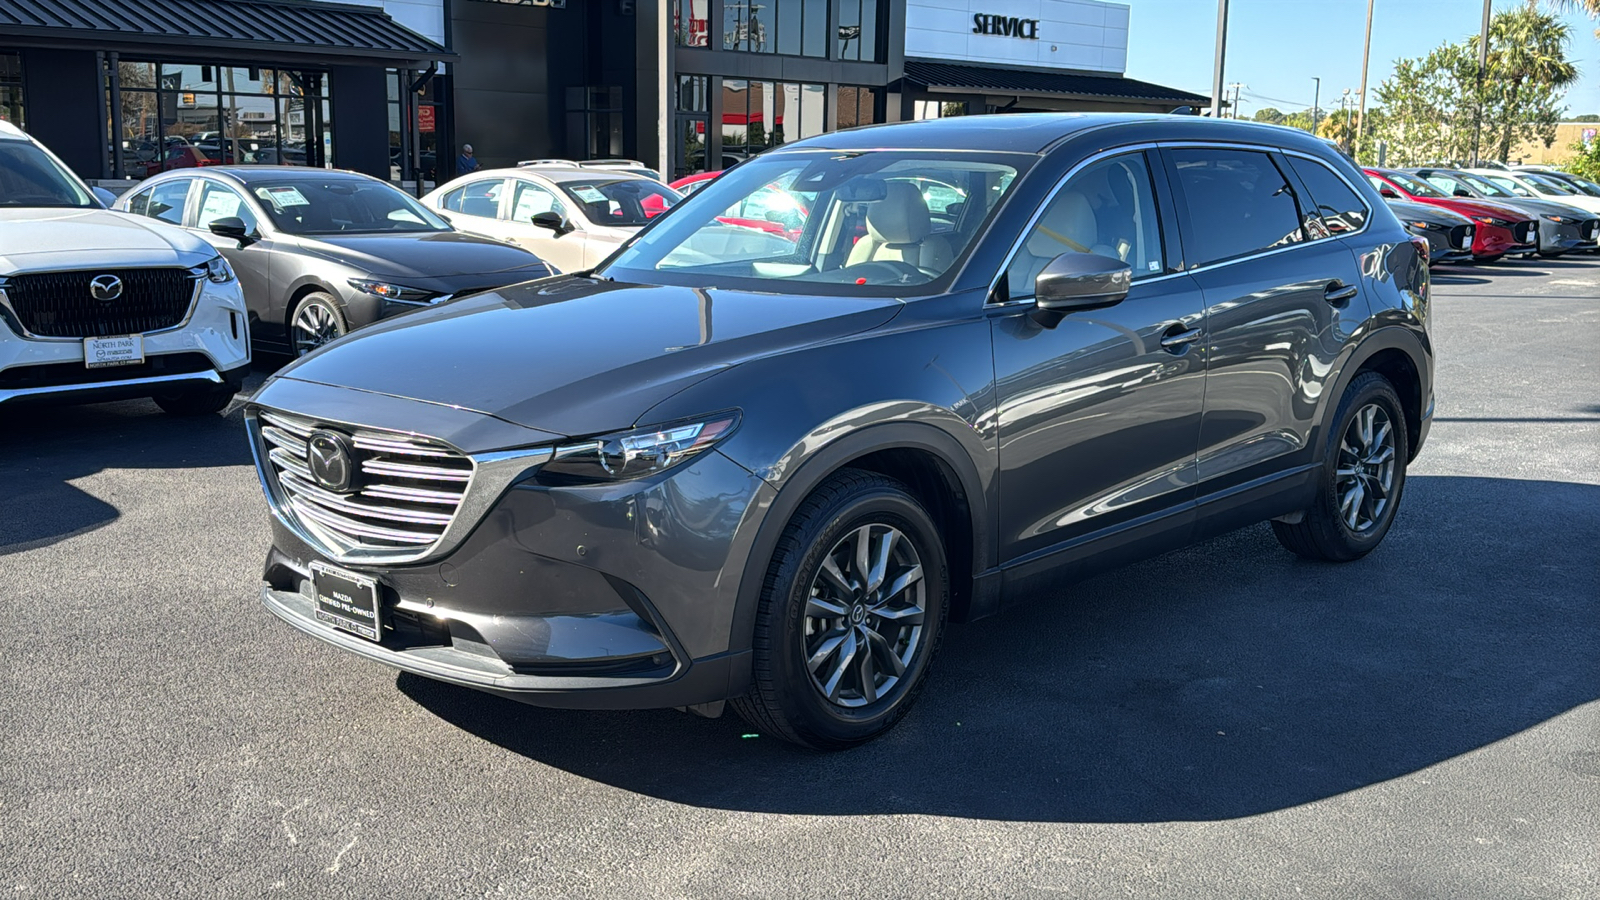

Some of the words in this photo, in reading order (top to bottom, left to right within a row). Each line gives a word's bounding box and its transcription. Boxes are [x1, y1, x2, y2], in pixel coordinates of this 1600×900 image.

[973, 12, 1040, 40] SERVICE
[93, 341, 116, 350] NORTH
[319, 594, 341, 608] CERTIFIED
[341, 603, 374, 618] PRE-OWNED
[333, 591, 353, 603] MAZDA
